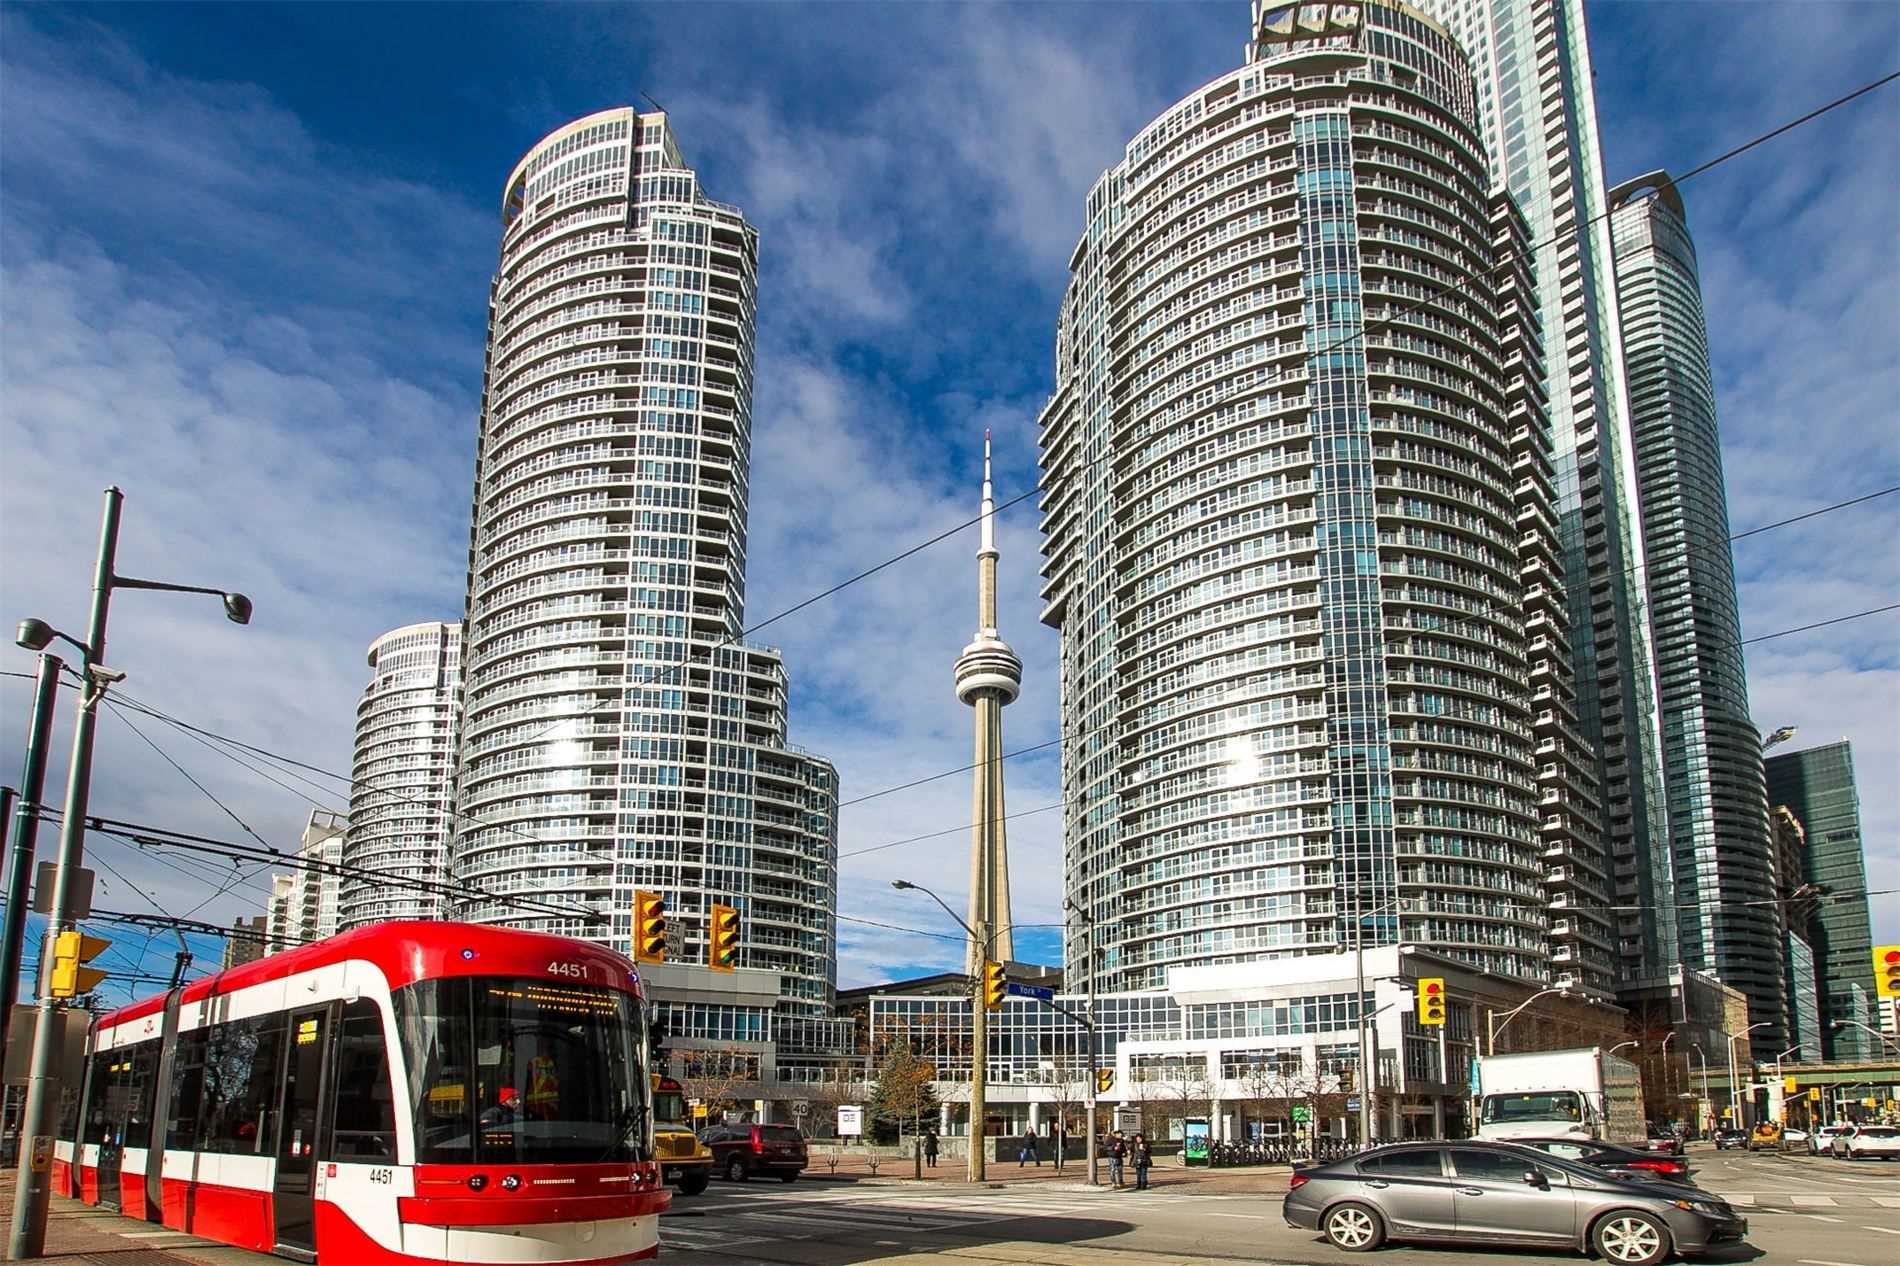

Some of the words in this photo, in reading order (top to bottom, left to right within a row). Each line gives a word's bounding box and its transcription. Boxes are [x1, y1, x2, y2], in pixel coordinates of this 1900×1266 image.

[547, 961, 589, 979] 4451
[1019, 984, 1035, 996] York
[792, 1104, 808, 1114] 40
[369, 1168, 393, 1185] 4451
